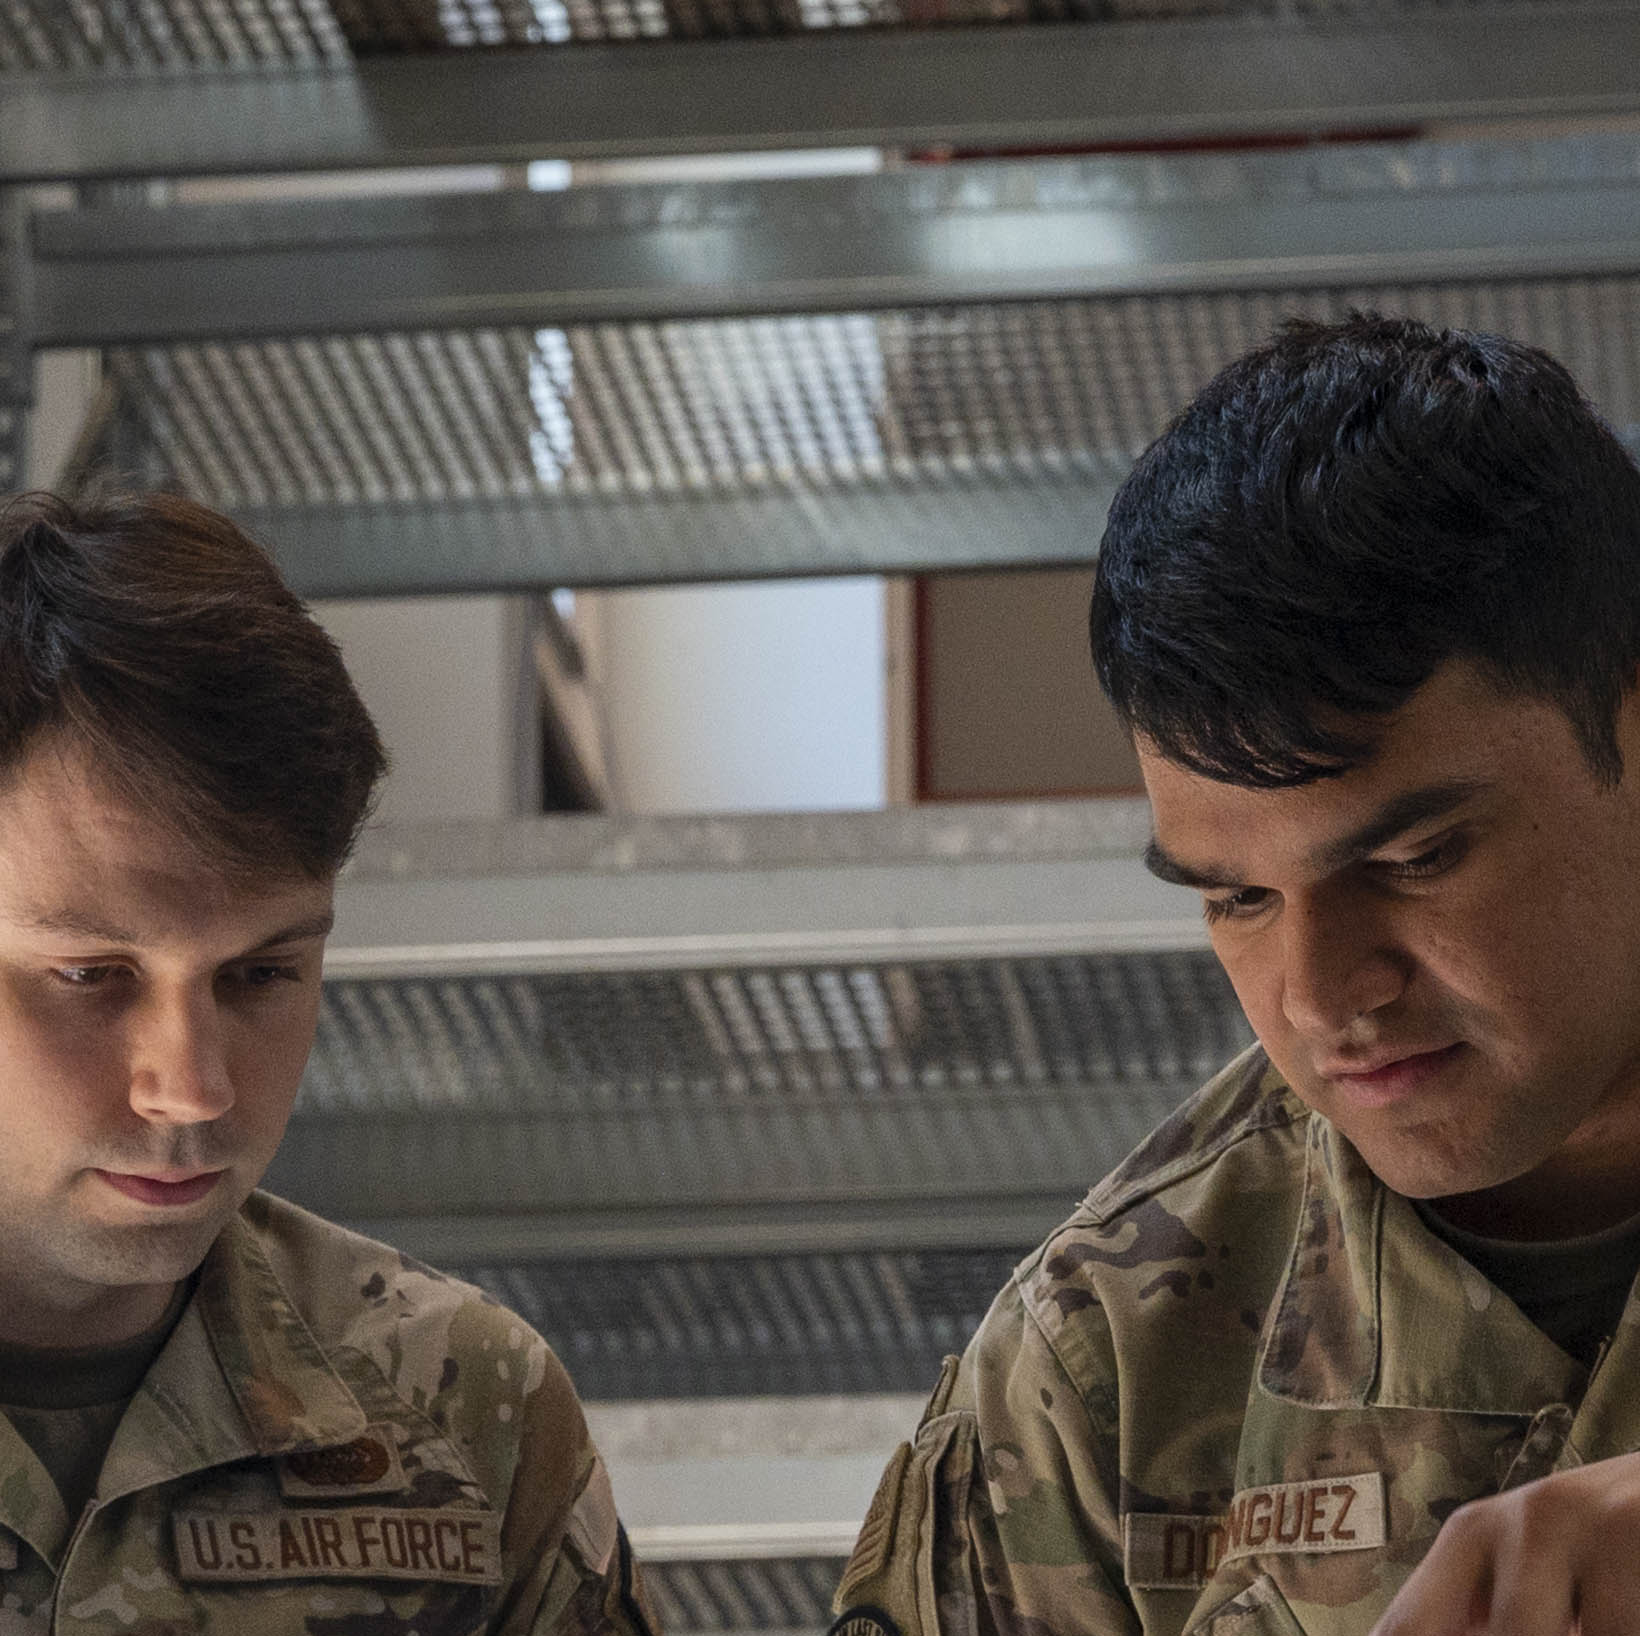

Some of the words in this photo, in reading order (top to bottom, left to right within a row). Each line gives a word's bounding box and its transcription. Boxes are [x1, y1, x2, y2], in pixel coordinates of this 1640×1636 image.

[188, 1518, 274, 1571] U.S.
[279, 1516, 348, 1570] AIR
[352, 1516, 486, 1574] FORCE
